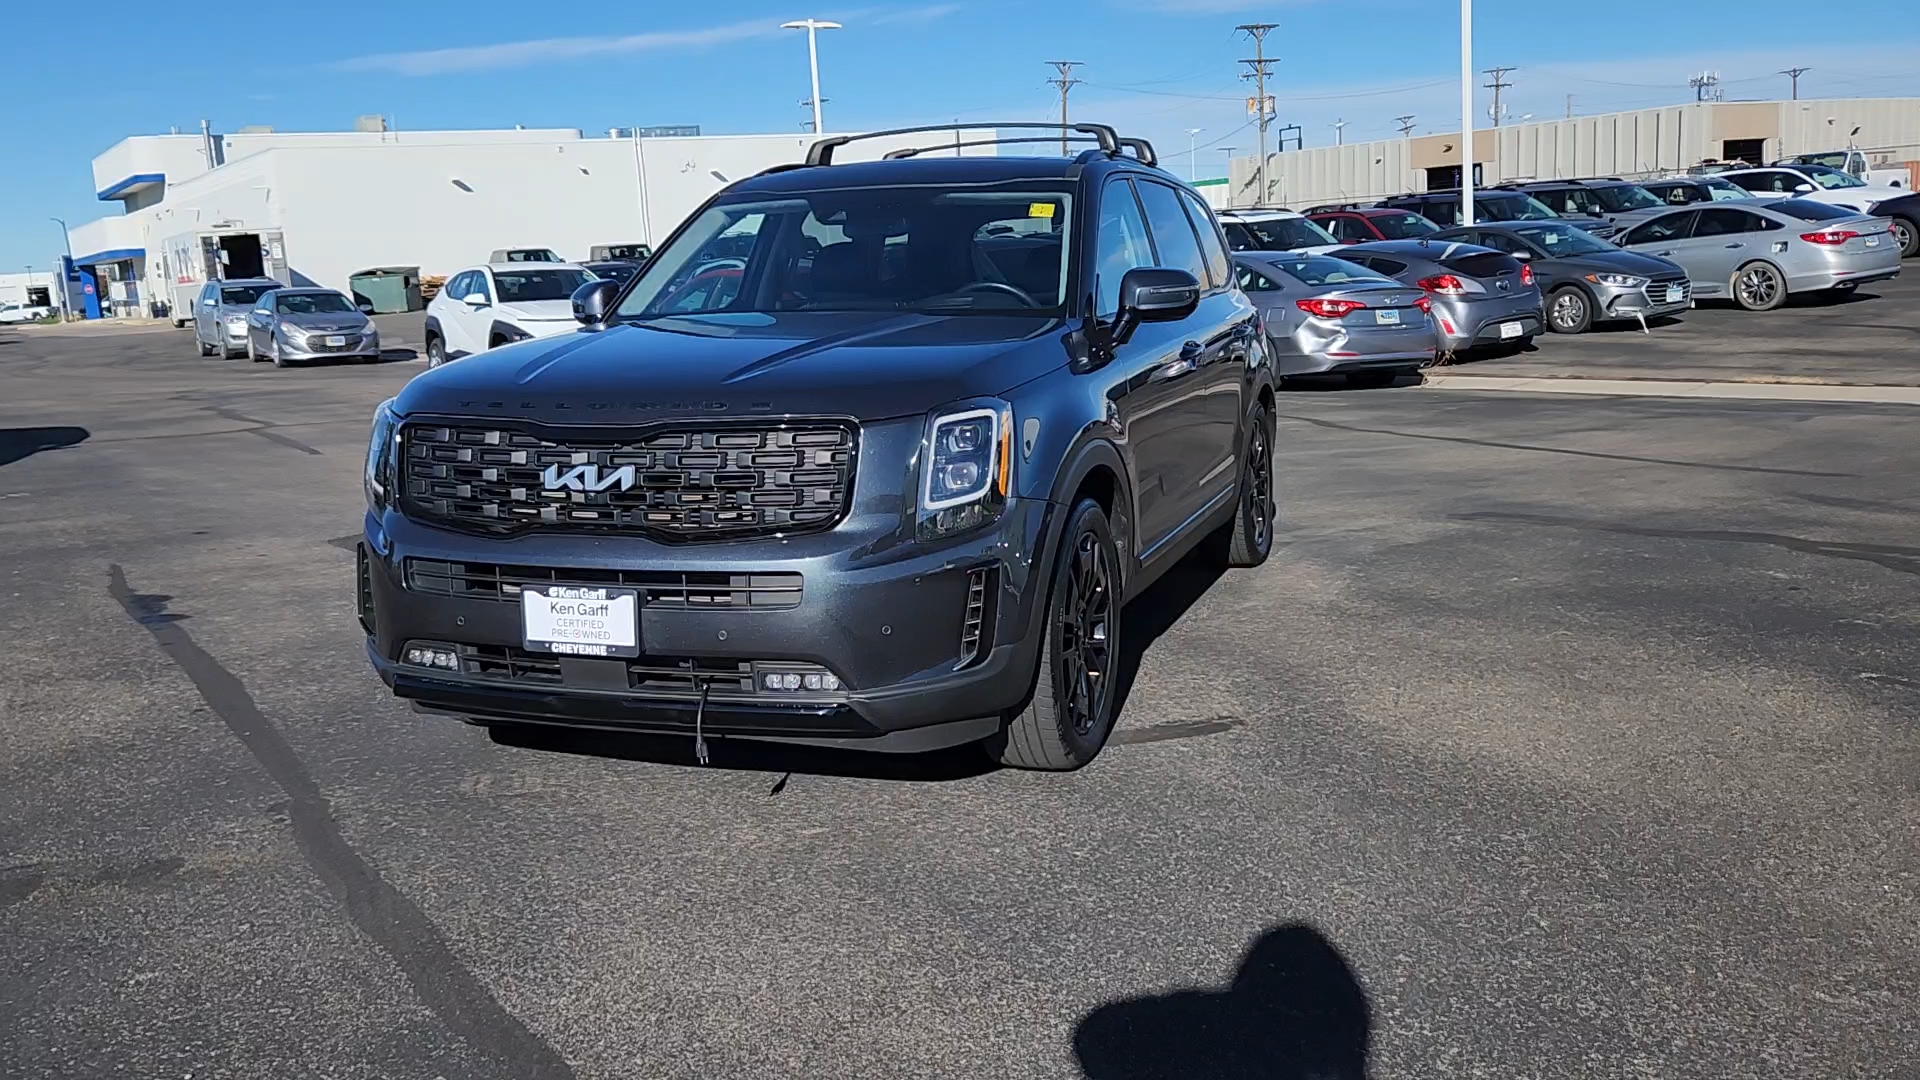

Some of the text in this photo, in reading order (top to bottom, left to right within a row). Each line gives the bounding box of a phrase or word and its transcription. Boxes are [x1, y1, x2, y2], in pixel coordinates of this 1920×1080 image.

[544, 462, 636, 492] KIA
[558, 587, 607, 600] Ken Garff
[550, 601, 609, 617] Ken Garff
[556, 618, 605, 629] CERTIFIED
[551, 628, 611, 640] PRE-OWNED
[551, 642, 608, 656] CHEYENNE
